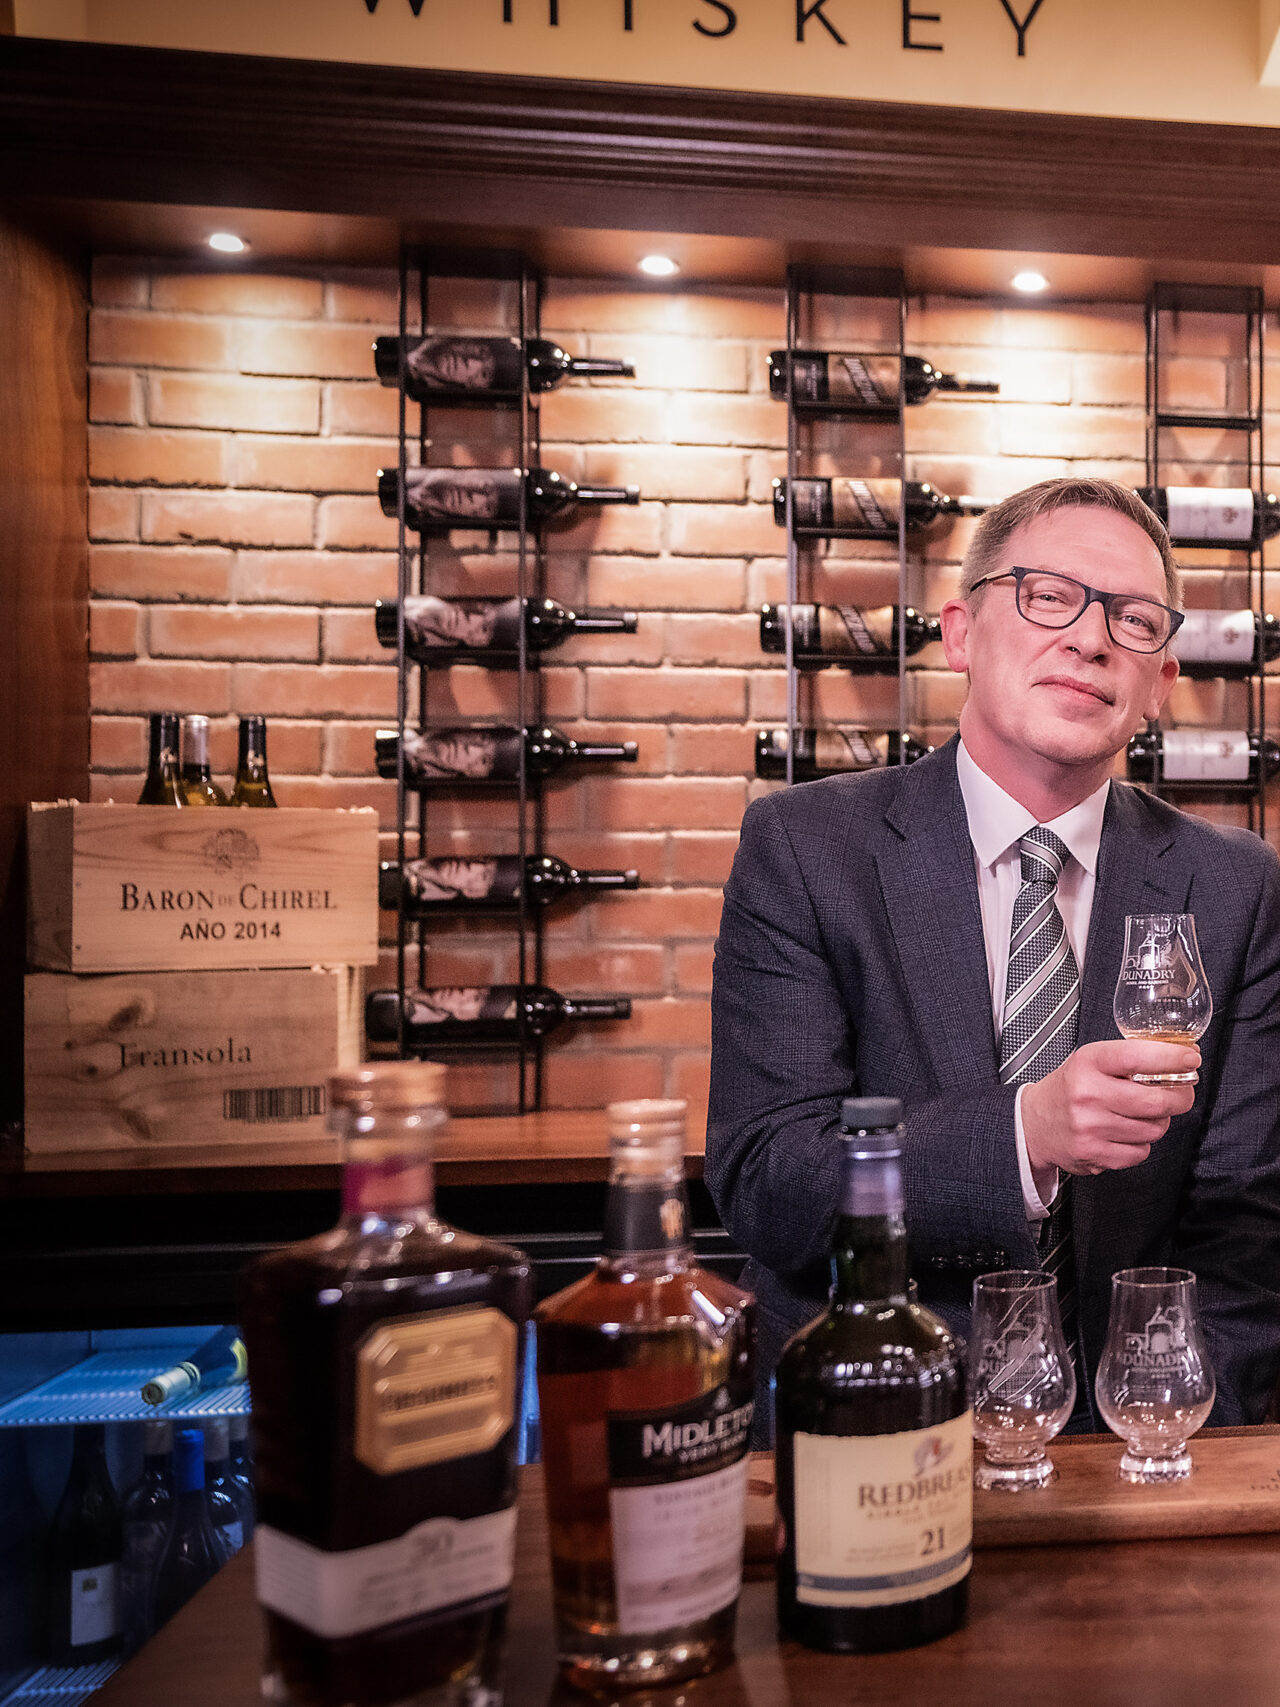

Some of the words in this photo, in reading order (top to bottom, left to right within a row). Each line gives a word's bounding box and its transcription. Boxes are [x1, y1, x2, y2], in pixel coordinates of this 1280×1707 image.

[361, 0, 1044, 58] SKEY
[120, 882, 213, 911] BARON
[239, 882, 338, 911] CHIREL
[180, 918, 226, 941] AÑO
[234, 921, 281, 940] 2014
[1122, 969, 1176, 981] DUNADRY
[120, 1037, 252, 1068] Fransola
[641, 1401, 757, 1458] MIDLETO
[920, 1527, 946, 1557] 21
